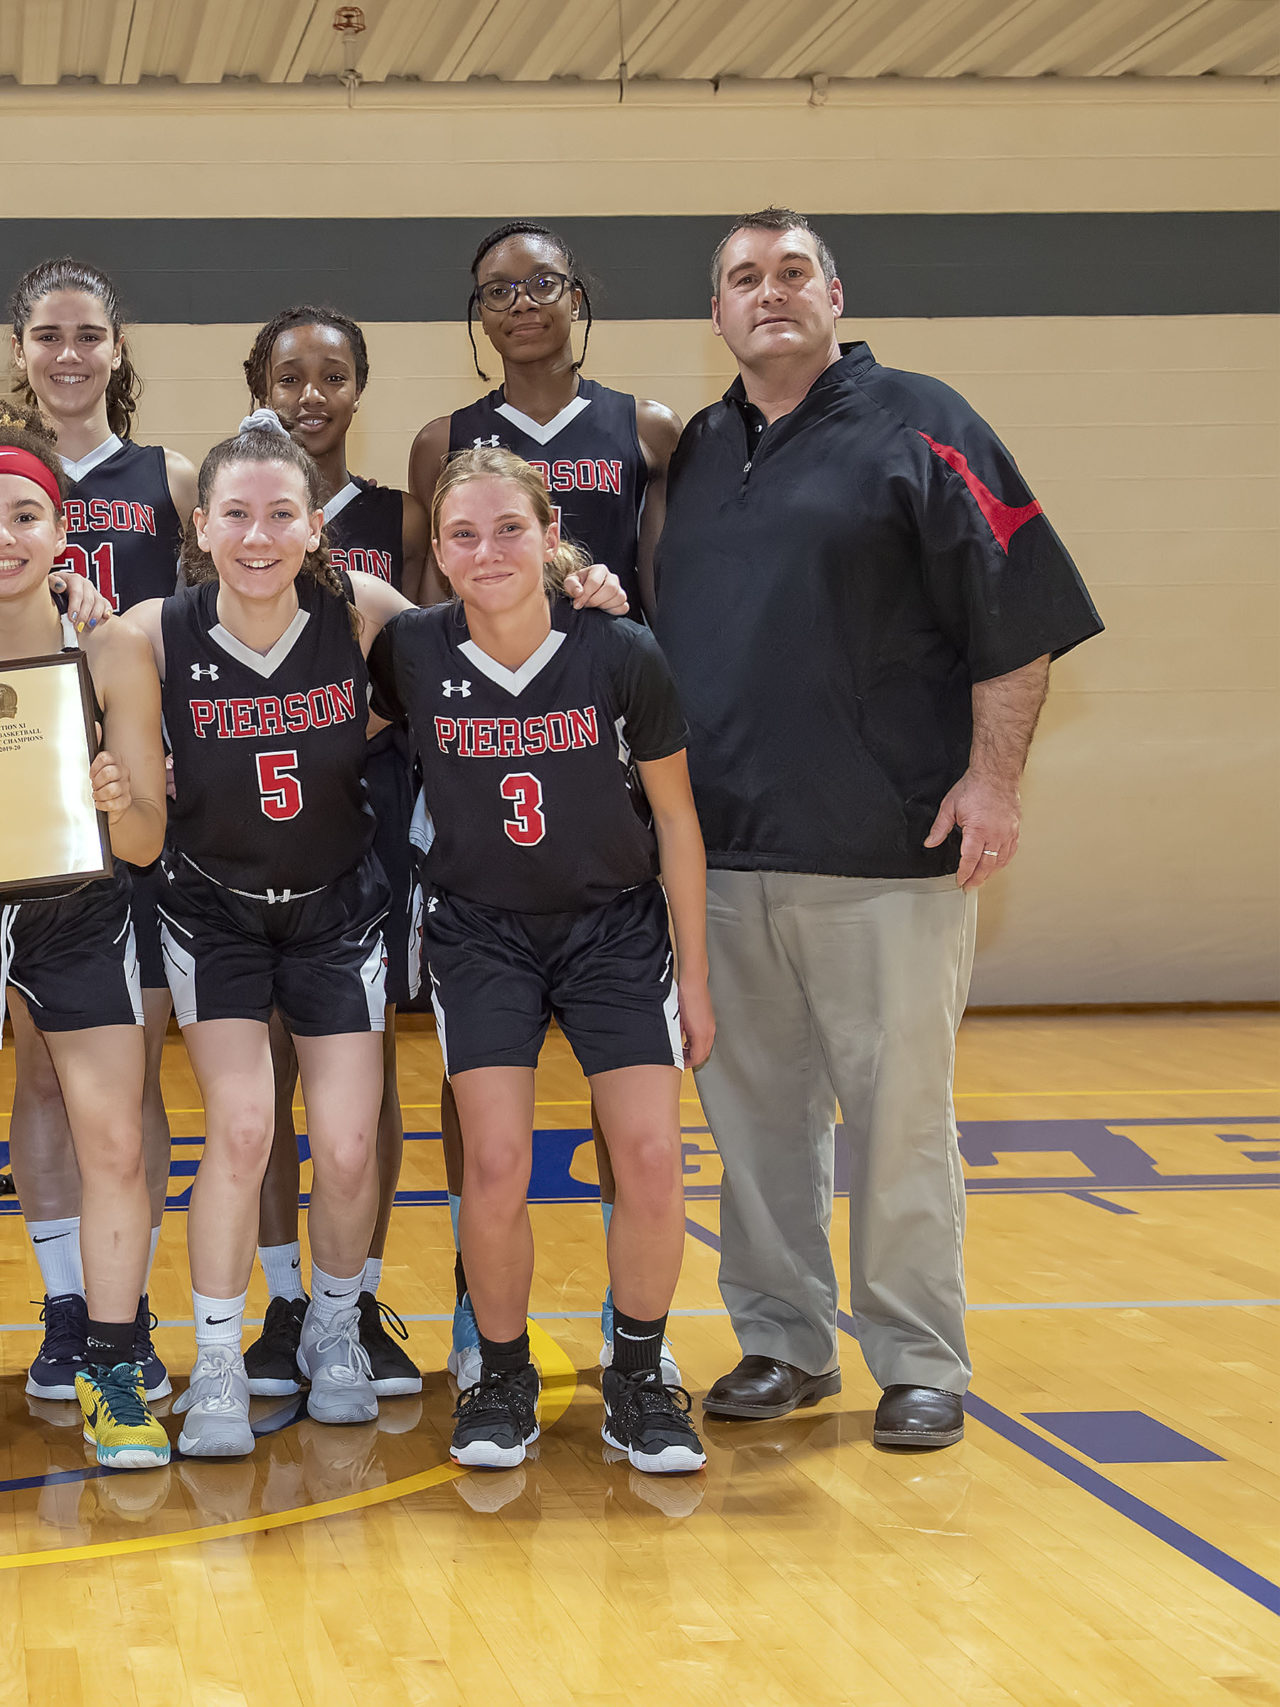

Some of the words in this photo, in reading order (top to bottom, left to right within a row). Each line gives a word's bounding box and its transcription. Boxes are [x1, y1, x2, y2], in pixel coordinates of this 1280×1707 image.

[189, 678, 356, 739] PIERSON
[434, 705, 599, 758] PIERSON
[2, 735, 44, 745] CHAMPIONS
[255, 750, 303, 821] 5
[500, 772, 546, 846] 3
